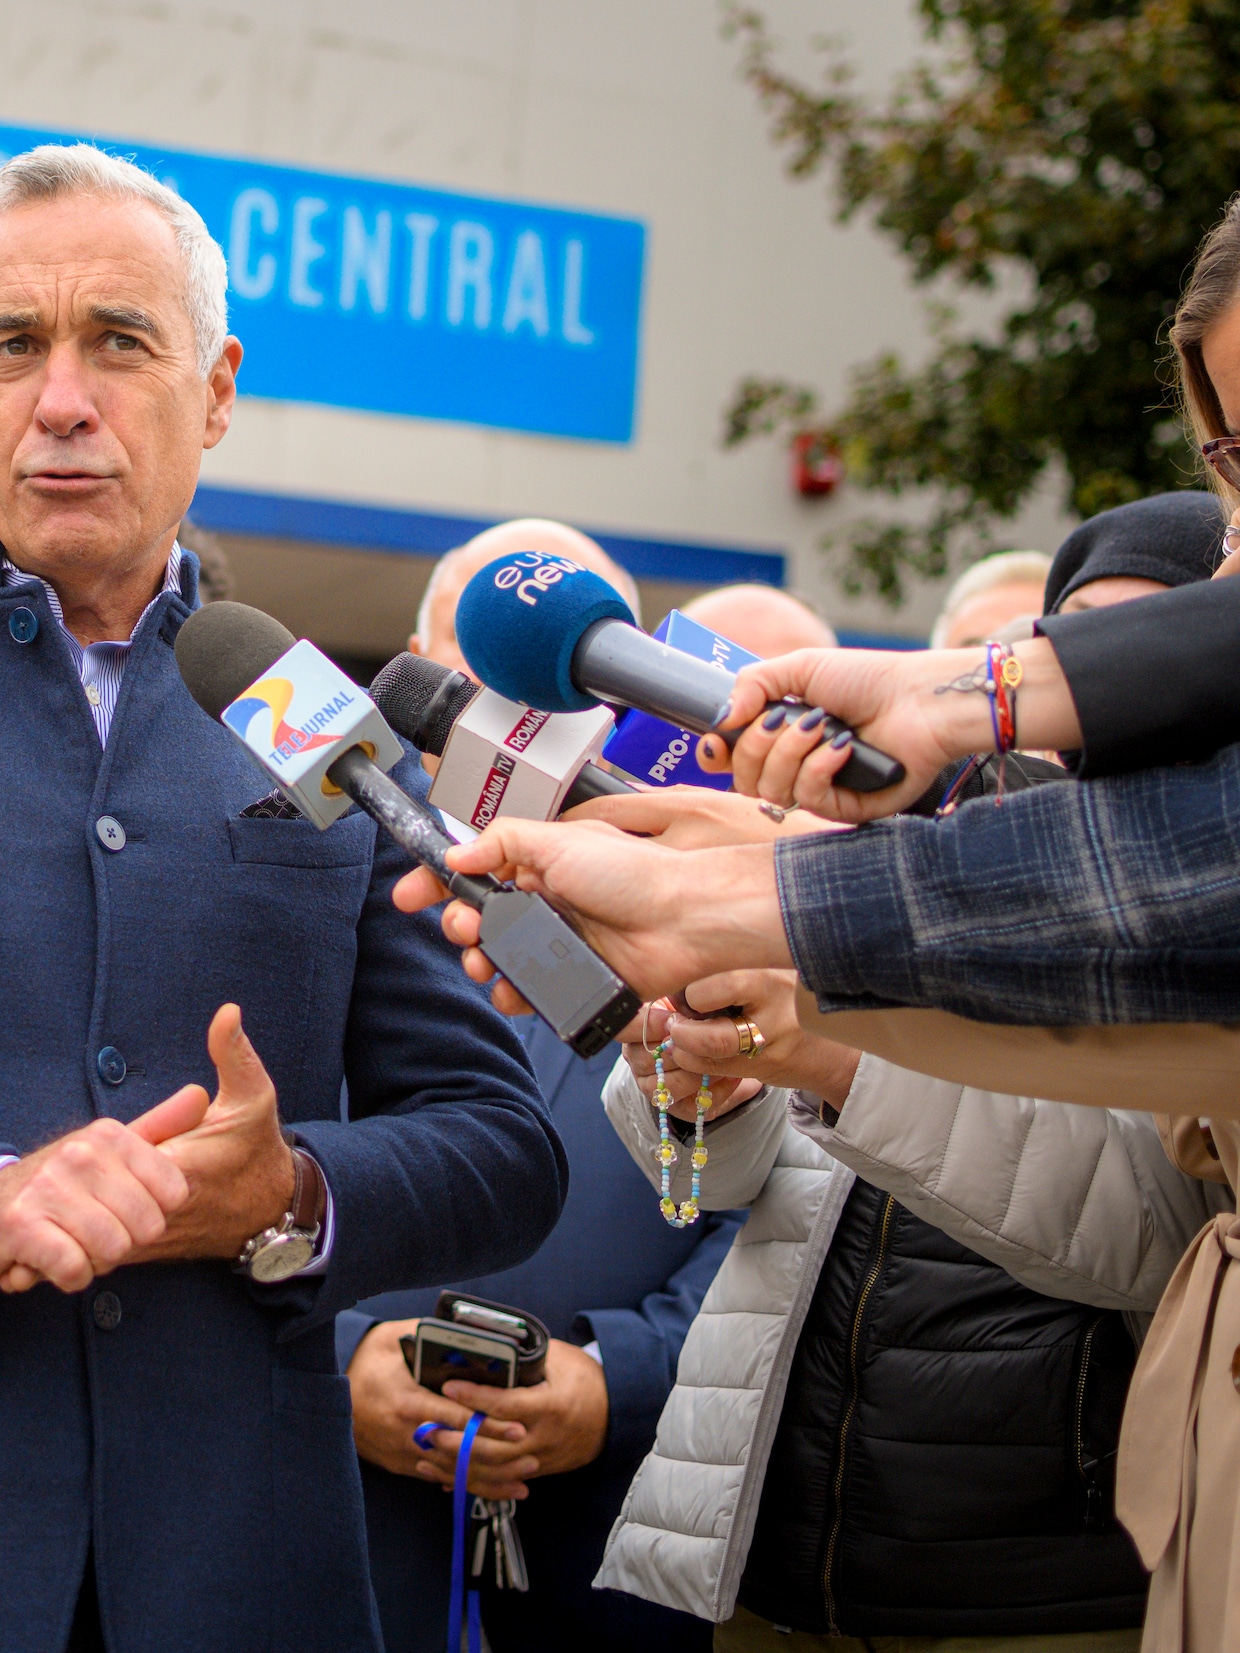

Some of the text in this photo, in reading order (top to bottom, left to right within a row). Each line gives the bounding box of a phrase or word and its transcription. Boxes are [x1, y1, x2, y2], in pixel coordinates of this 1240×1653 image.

[229, 188, 595, 345] CENTRAL
[517, 559, 596, 606] new
[268, 691, 355, 766] TELEJURNAL
[496, 754, 513, 773] TV
